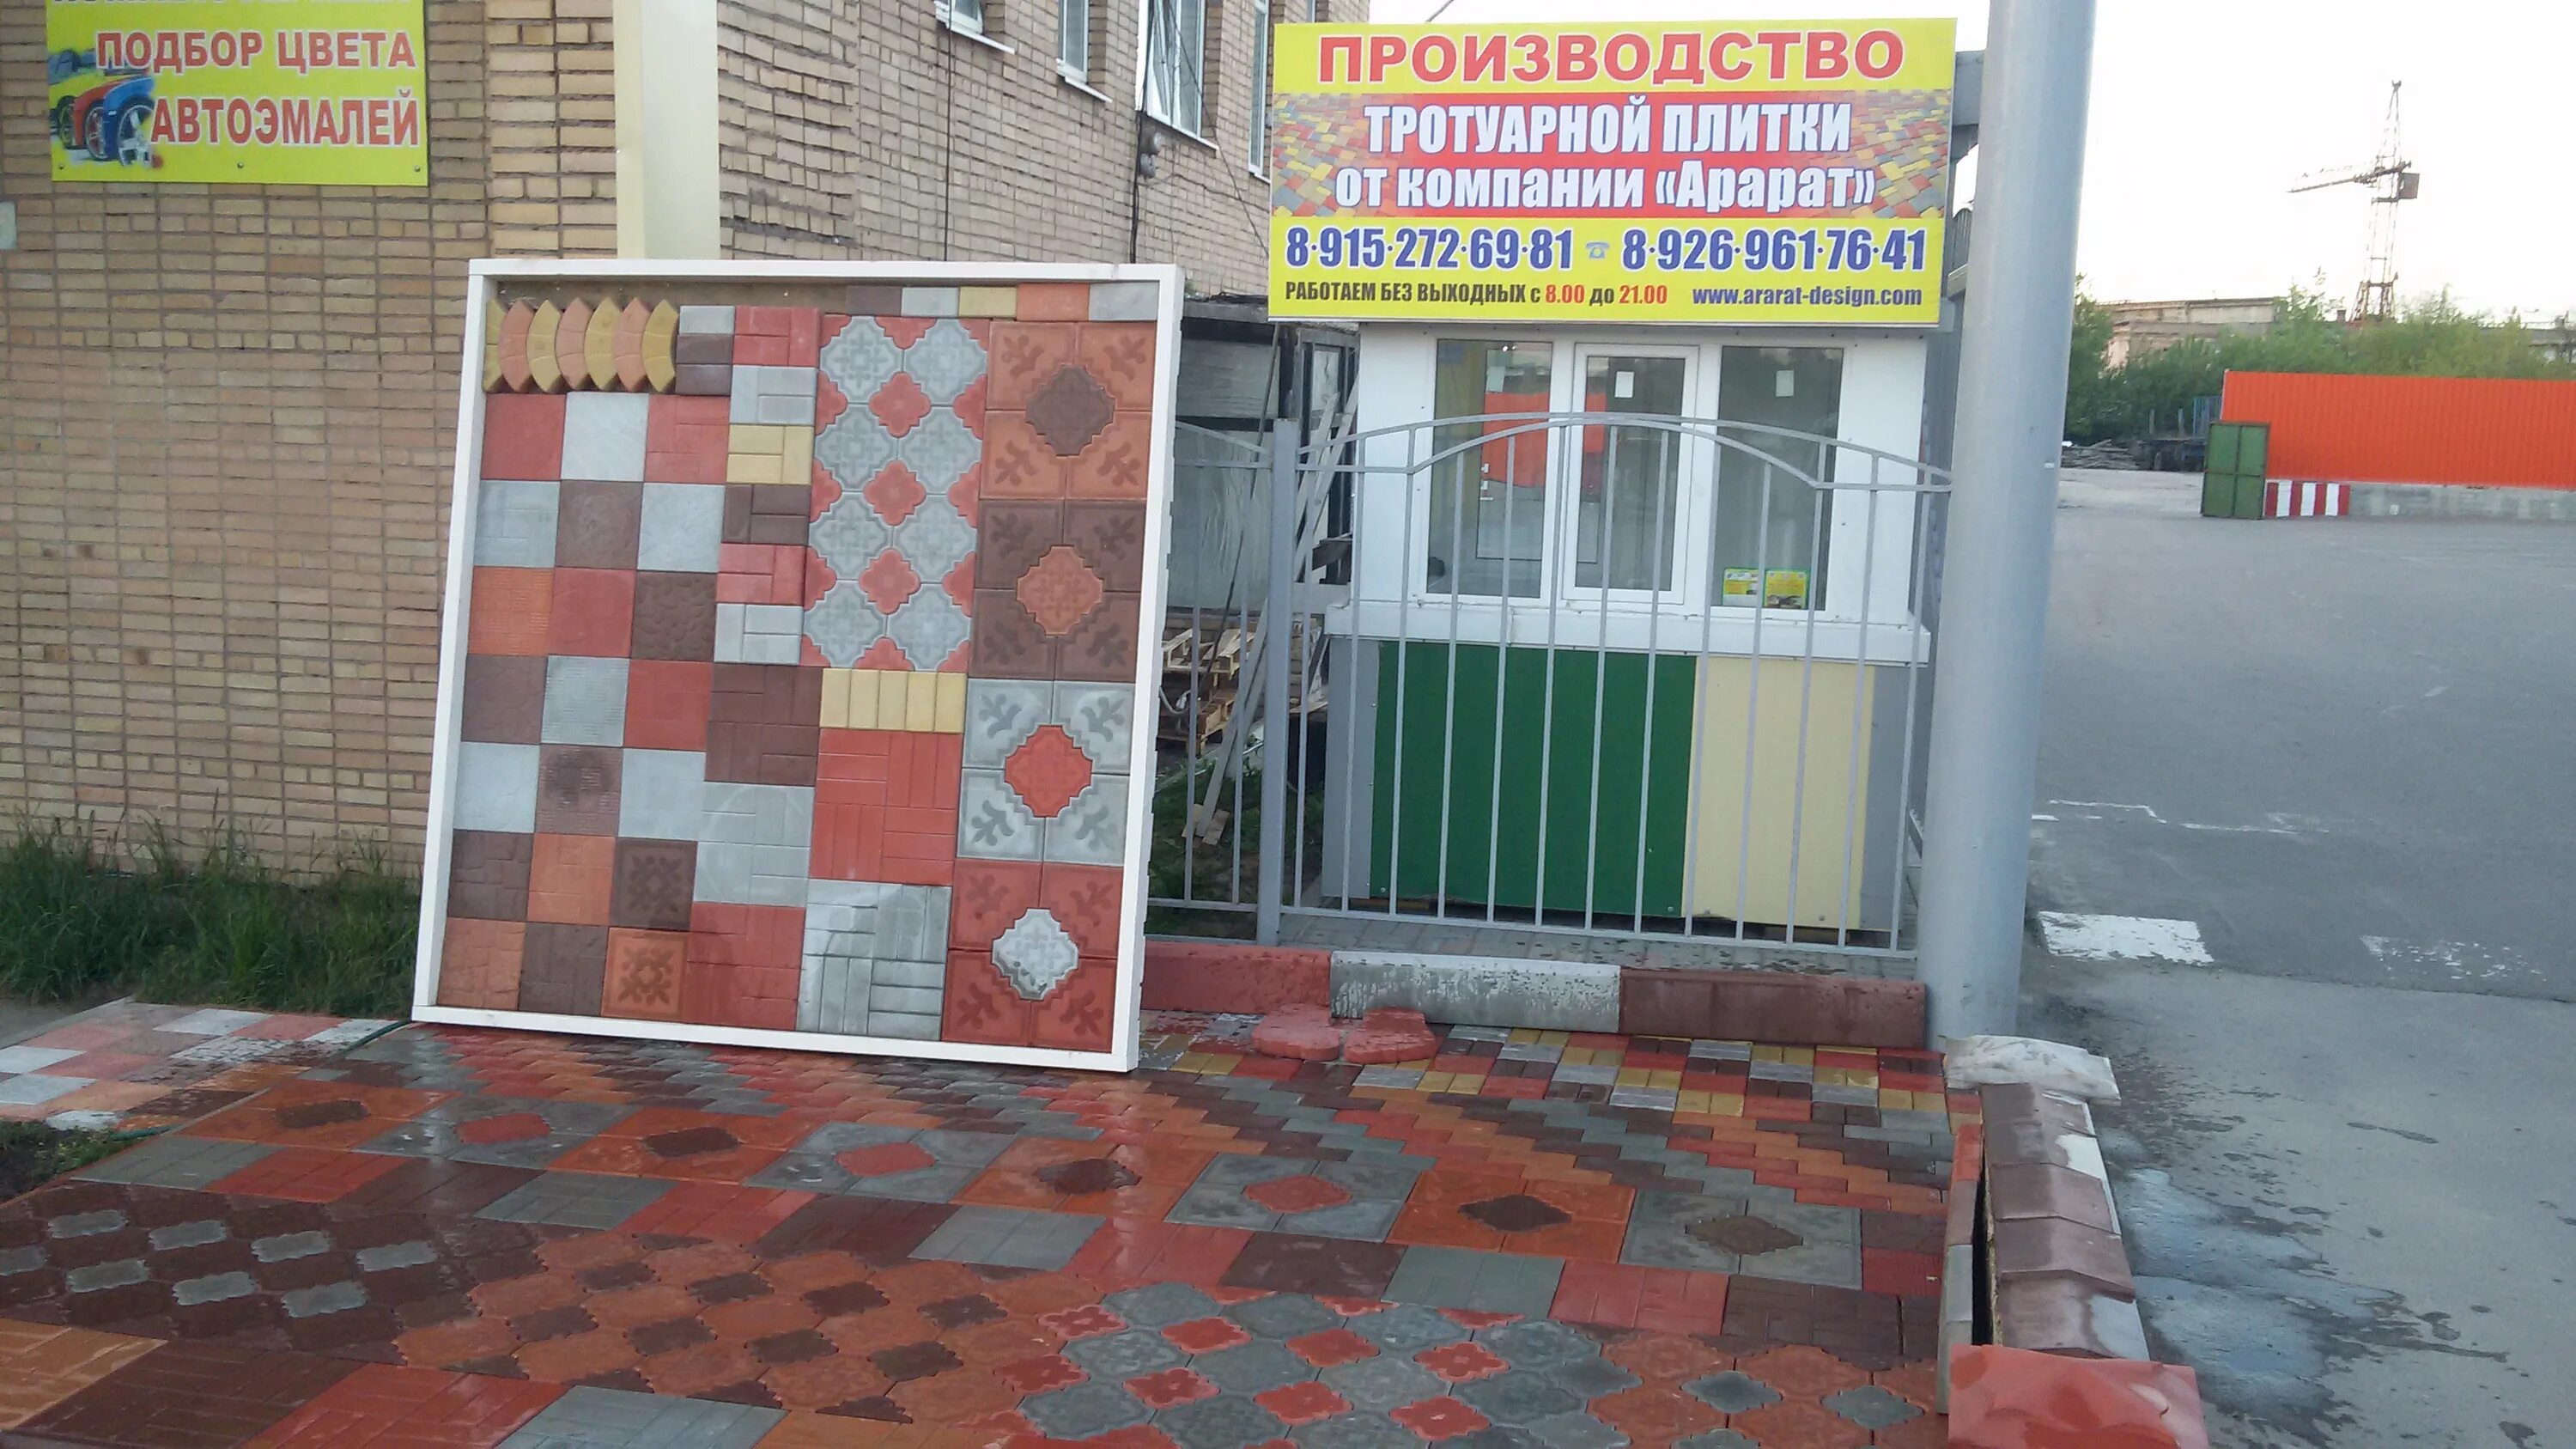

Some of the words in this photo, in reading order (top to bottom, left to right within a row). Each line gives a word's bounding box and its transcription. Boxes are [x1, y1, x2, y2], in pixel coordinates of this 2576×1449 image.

[97, 32, 262, 74] ПОДБОР
[278, 32, 416, 74] ЦВЕТА
[1319, 30, 1904, 85] ПРОИЗВОДСТВО
[151, 88, 419, 145] АВТОЭМАЛЕЙ
[1364, 94, 1651, 154] ТРОТУАРНОЙ
[1662, 103, 1851, 152] ПЛИТКИ
[1335, 167, 1388, 207] от
[1397, 167, 1645, 208] компании
[1656, 161, 1875, 213] «Арарат»
[1285, 282, 1375, 301] РАБОТАЕМ
[1380, 283, 1413, 301] БЕЗ
[1418, 283, 1526, 306] ВЫХОДНЫХ
[1530, 289, 1540, 303] с
[1545, 283, 1584, 304] 8.00
[1589, 288, 1614, 306] до
[1619, 284, 1668, 305] 21.00
[1692, 286, 1923, 307] www.ararat-design.com
